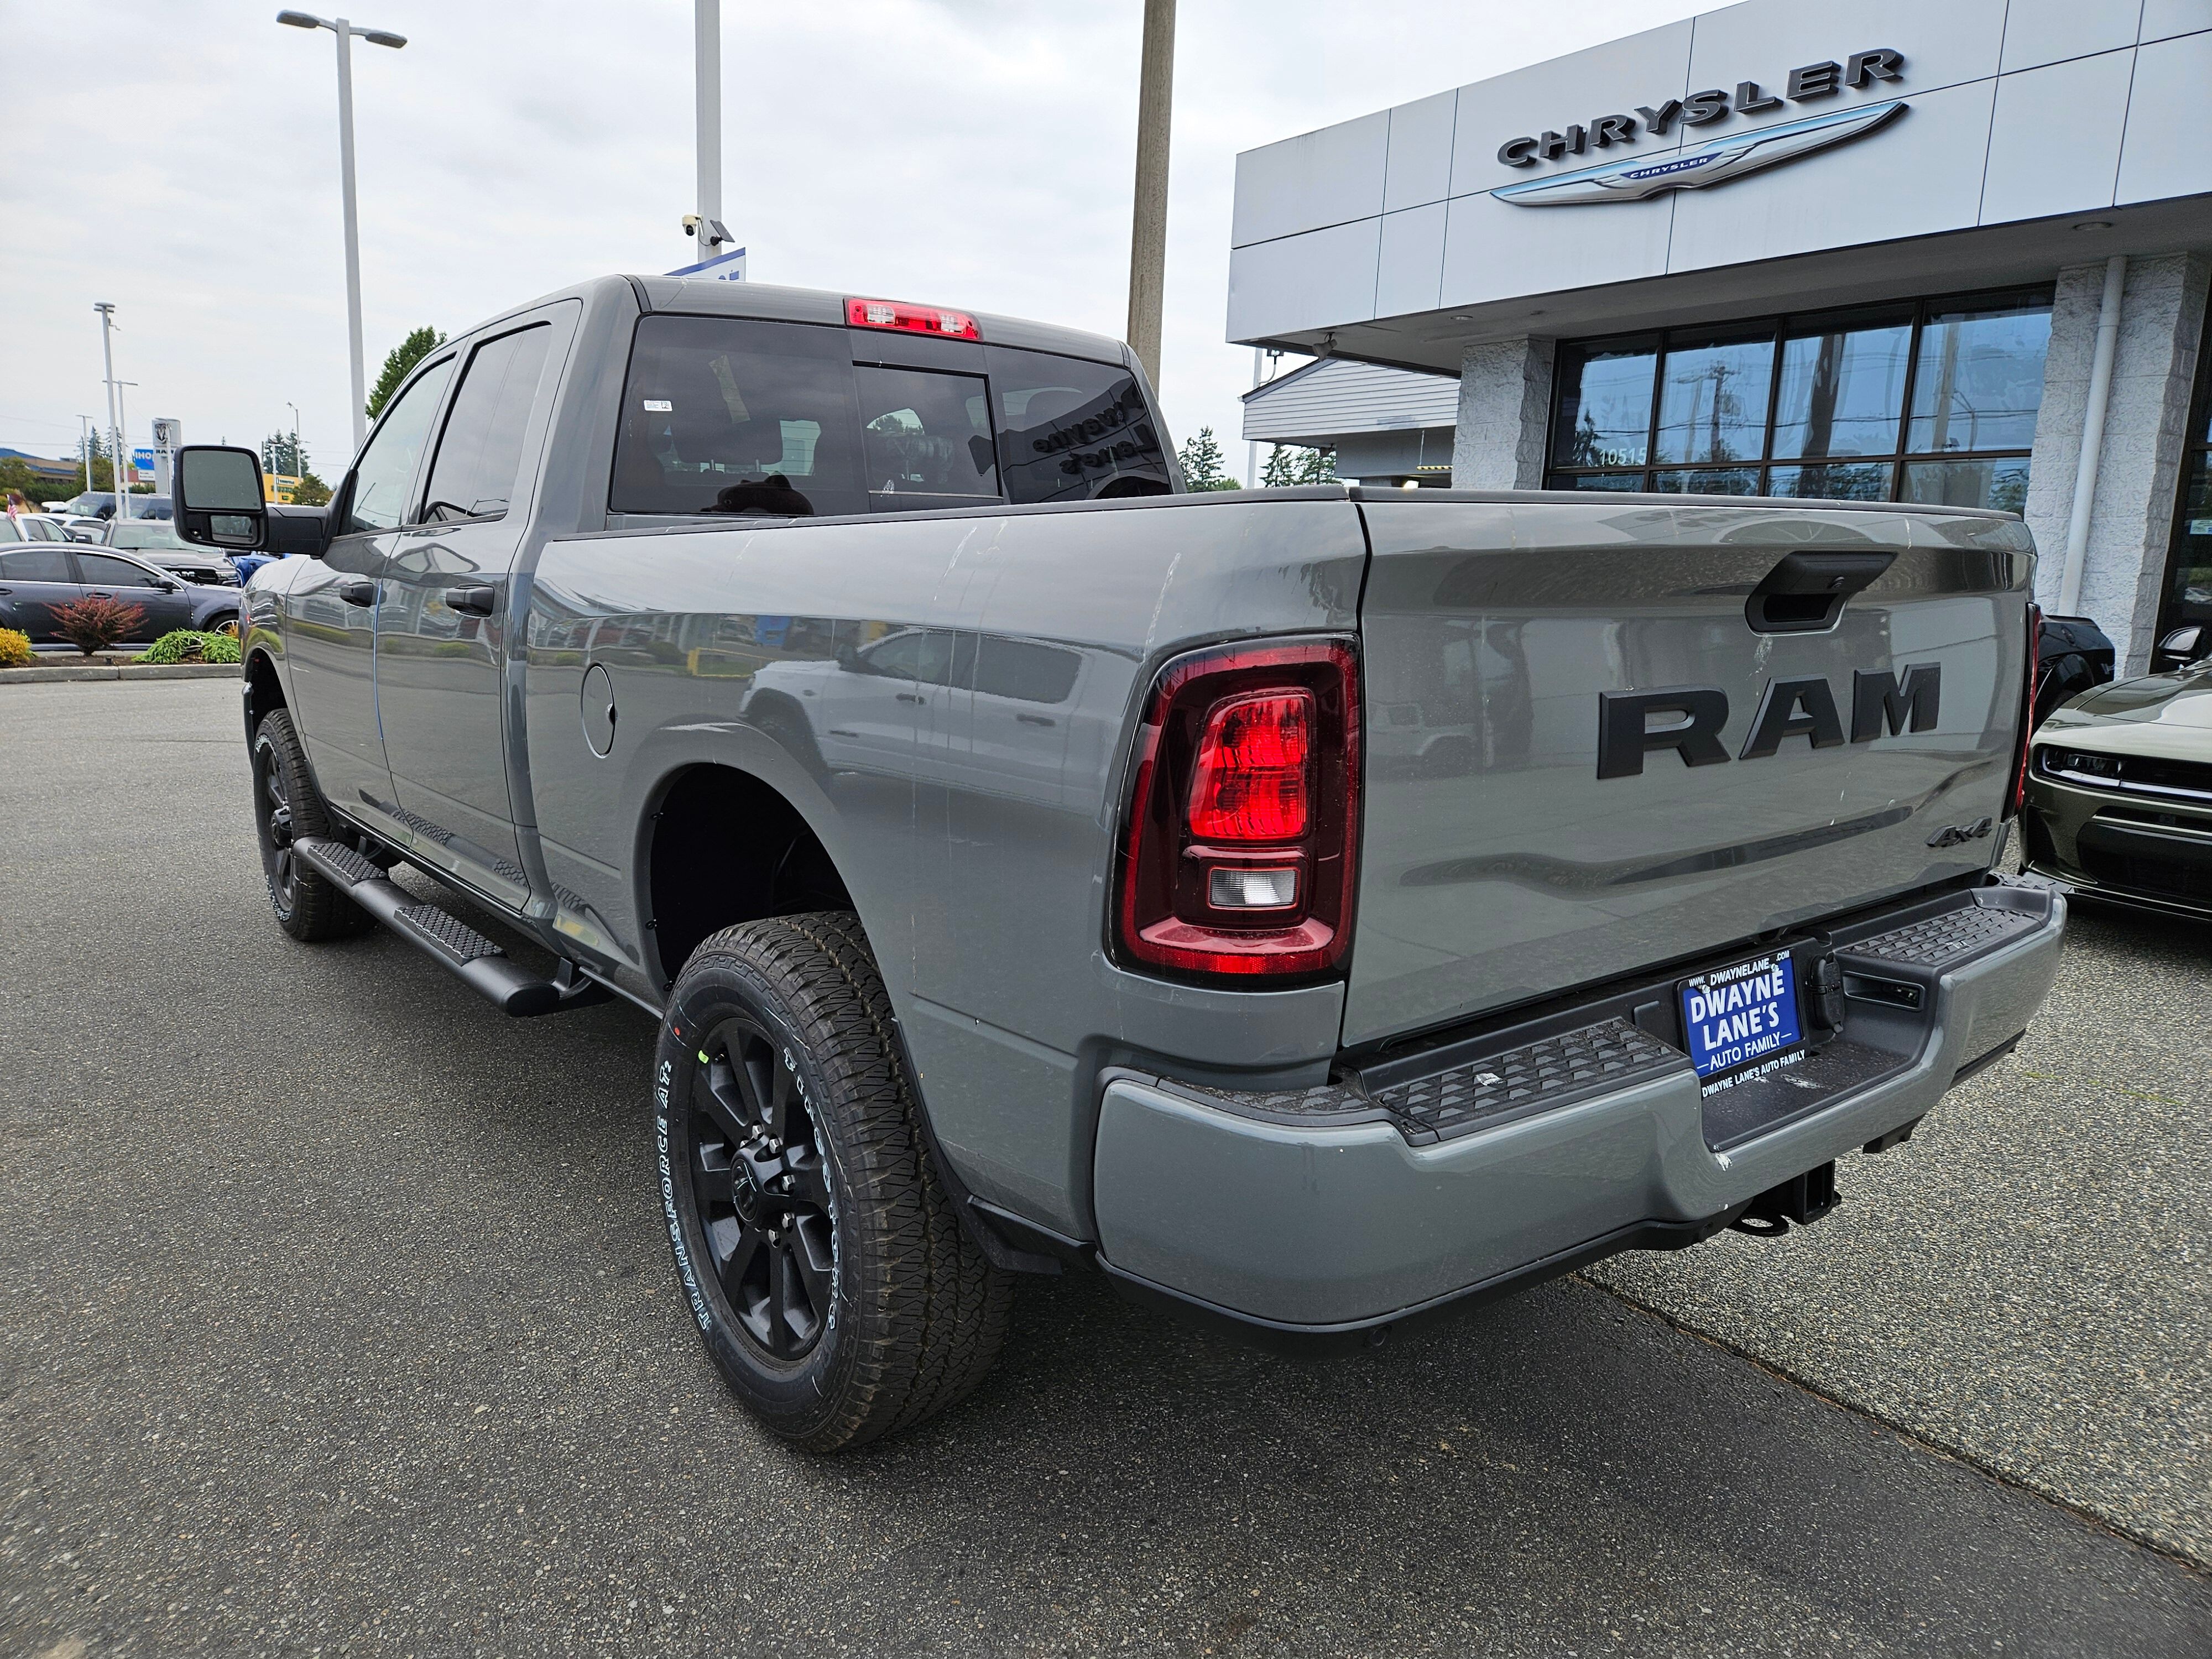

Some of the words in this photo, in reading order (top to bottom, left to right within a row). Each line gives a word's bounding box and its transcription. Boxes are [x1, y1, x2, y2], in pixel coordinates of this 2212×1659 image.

[1497, 48, 1905, 168] CHRYSLER
[1630, 158, 1708, 179] CHRYSLER
[135, 451, 153, 460] IHO
[1600, 447, 1647, 466] 10515
[1597, 662, 1942, 780] RAM
[1690, 969, 1785, 1024] DWAYNE
[1710, 957, 1770, 987] DWAYNELANE
[1703, 1001, 1780, 1051] LANE'S
[1702, 1076, 1734, 1098] DWAYNE
[1735, 1065, 1761, 1085] LANE'S
[1761, 1059, 1780, 1075] AUTO
[1780, 1049, 1806, 1068] FAMILY
[1710, 1046, 1742, 1071] AUTO
[1745, 1031, 1781, 1058] FAMILY
[656, 1115, 713, 1331] TRANSFORCE
